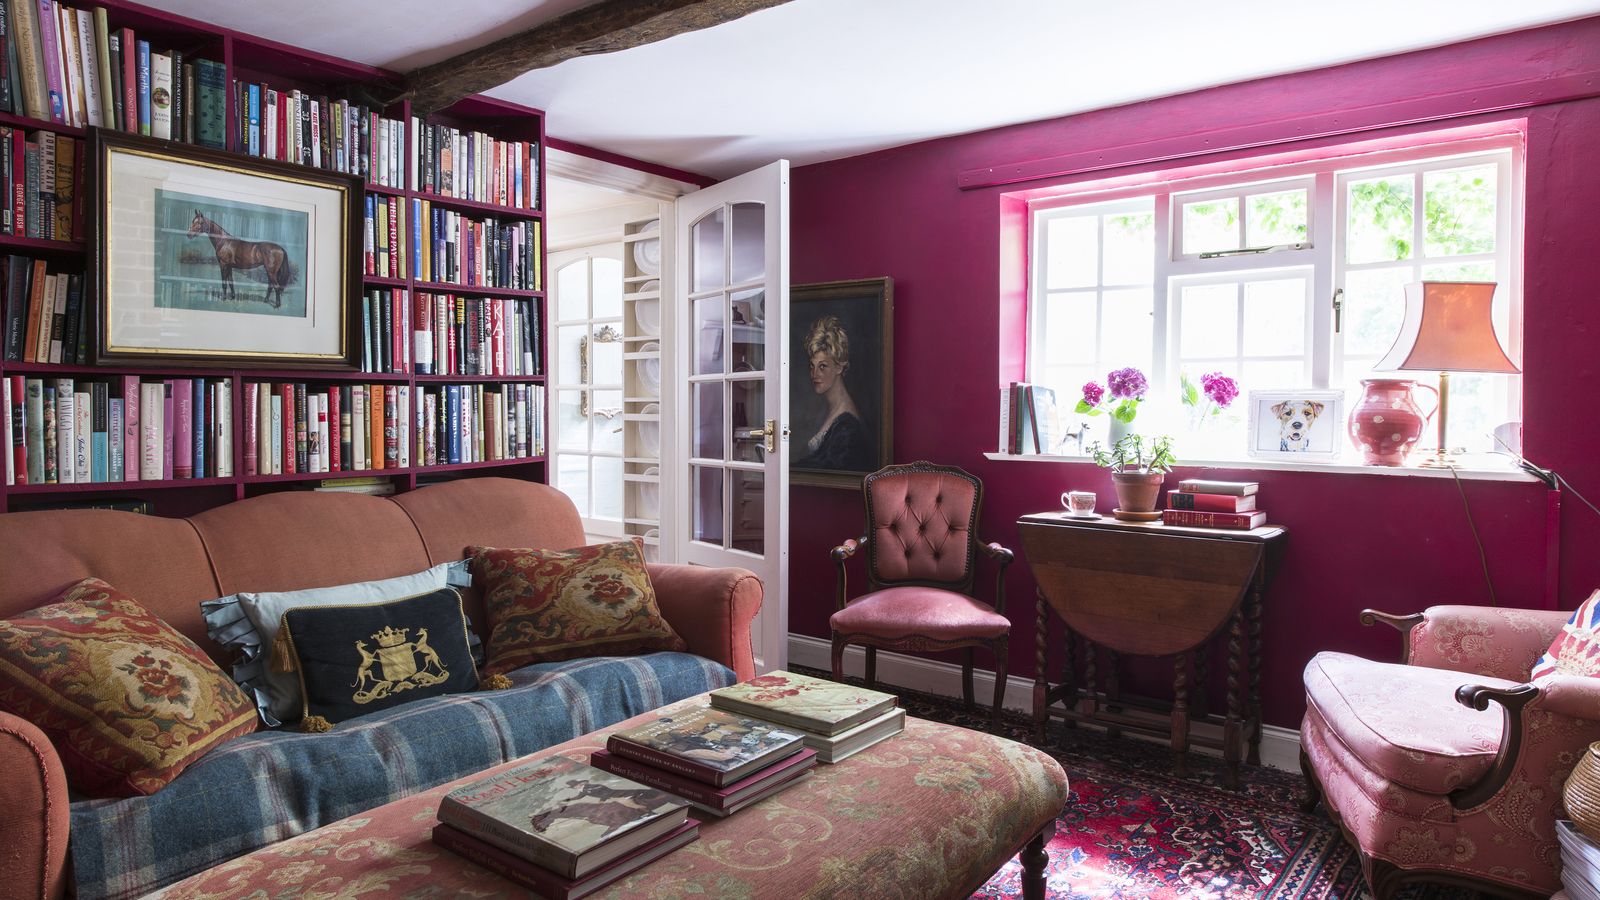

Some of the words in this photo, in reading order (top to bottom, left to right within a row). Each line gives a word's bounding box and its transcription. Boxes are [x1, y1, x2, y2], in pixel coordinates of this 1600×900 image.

[140, 66, 149, 94] Martha
[46, 134, 54, 156] JOHN
[46, 159, 54, 190] McCAIN
[390, 228, 396, 239] TO
[470, 311, 478, 350] CROSSFIRE
[127, 384, 138, 403] Perfect
[60, 400, 72, 431] TWIGGY
[76, 435, 85, 452] Julia
[610, 764, 626, 774] Perfect
[627, 768, 645, 781] English
[454, 784, 506, 805] Royal
